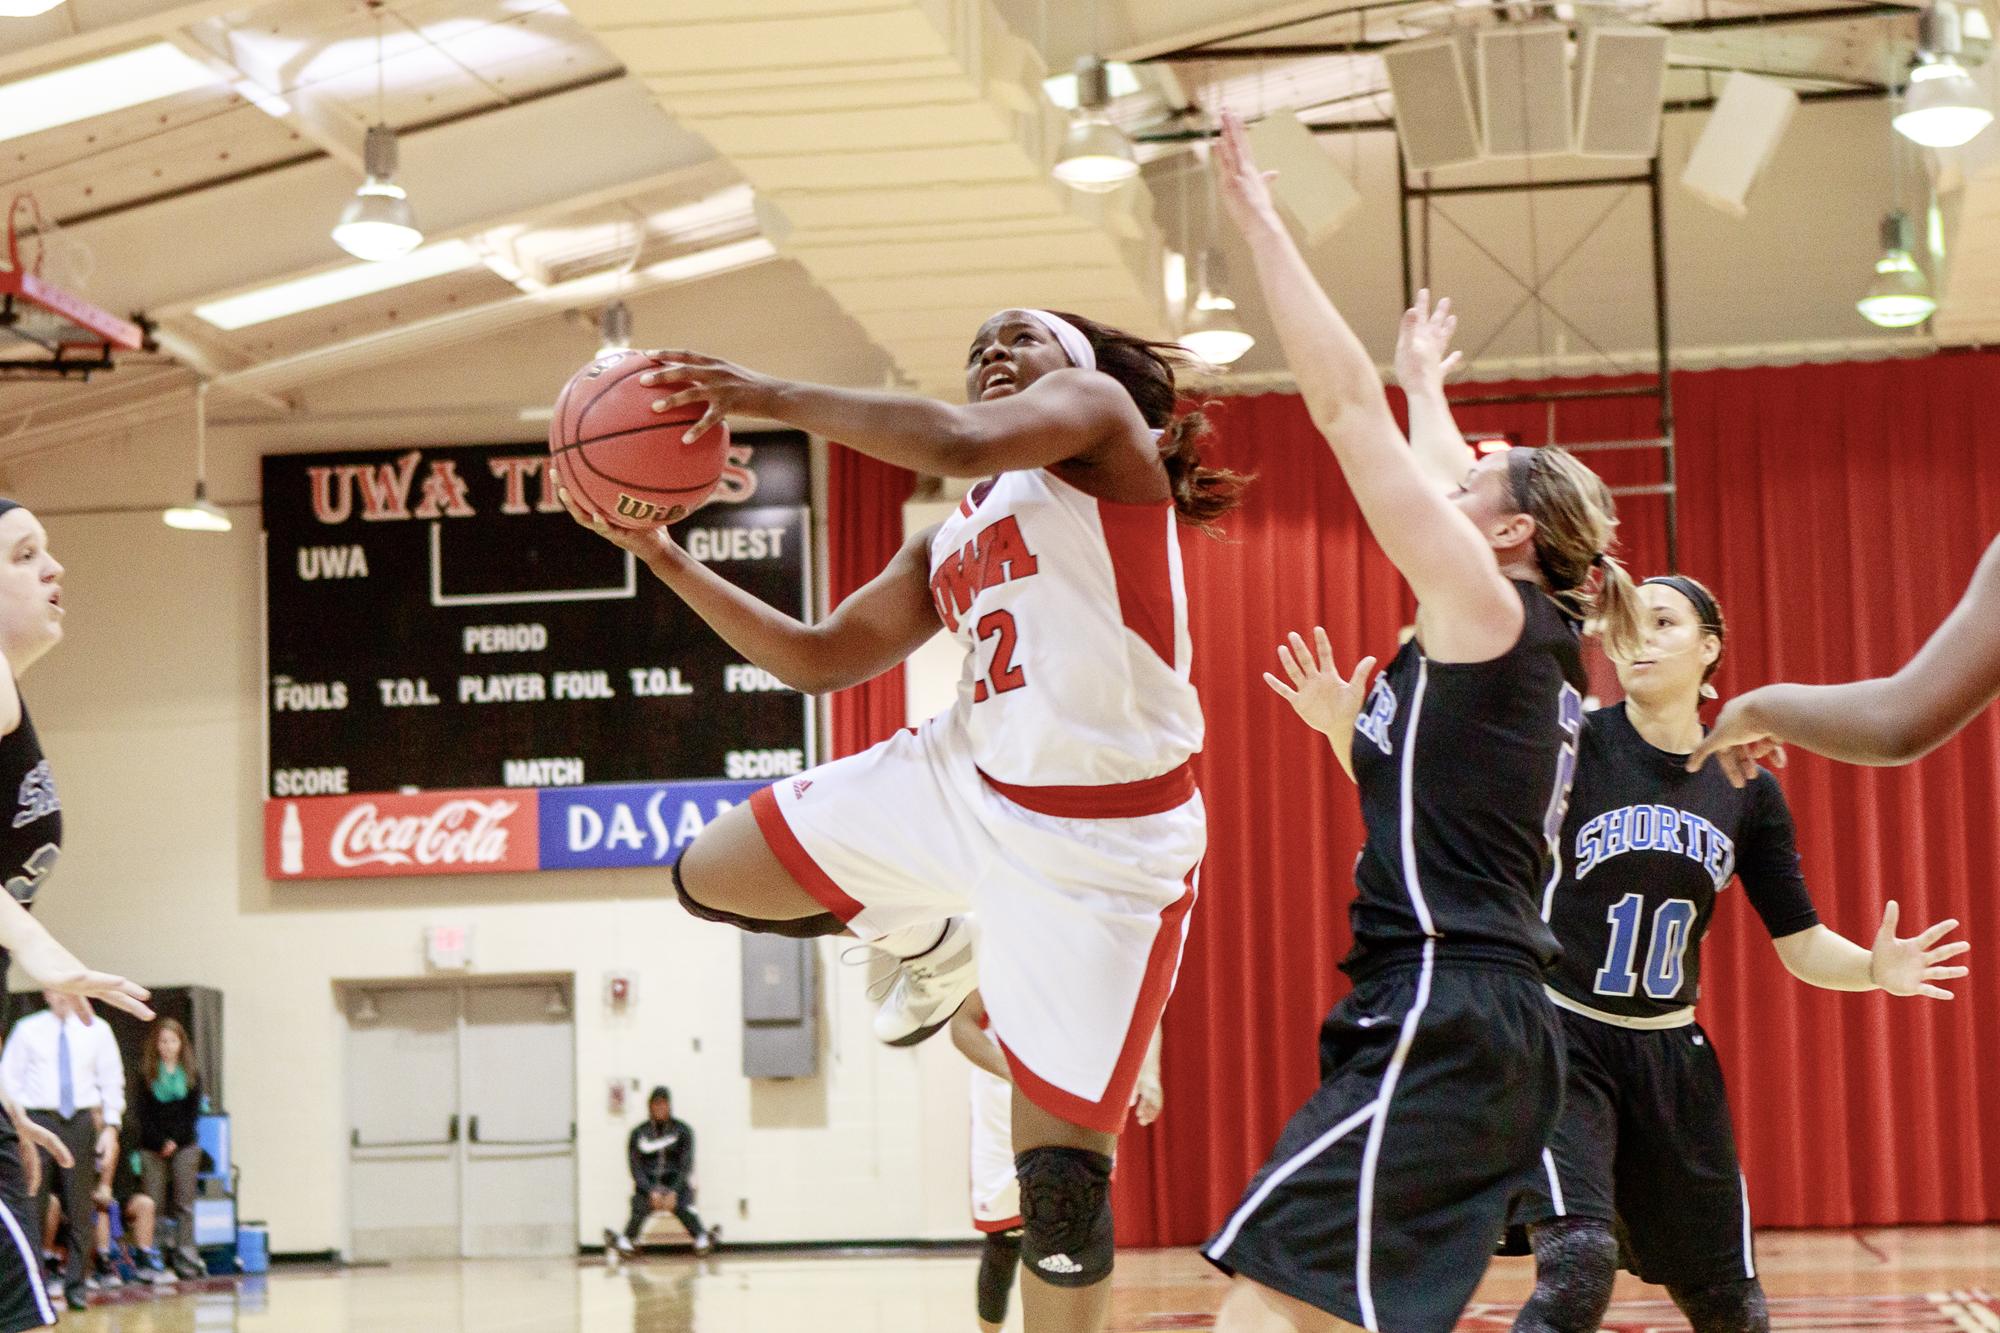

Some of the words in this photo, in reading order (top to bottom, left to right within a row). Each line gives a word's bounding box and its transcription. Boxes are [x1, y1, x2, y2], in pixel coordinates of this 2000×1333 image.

[308, 452, 475, 524] UWA
[688, 526, 786, 562] GUEST
[299, 545, 368, 581] UWA
[463, 624, 547, 654] PERIOD
[274, 681, 348, 711] FOULS
[457, 672, 546, 703] PLAYER
[553, 669, 615, 700] FOUL
[274, 766, 349, 796] SCORE
[504, 757, 585, 787] MATCH
[726, 748, 804, 779] SCORE
[568, 790, 735, 859] DASA
[1575, 804, 1735, 893] SHORTE
[1593, 892, 1697, 998] 10
